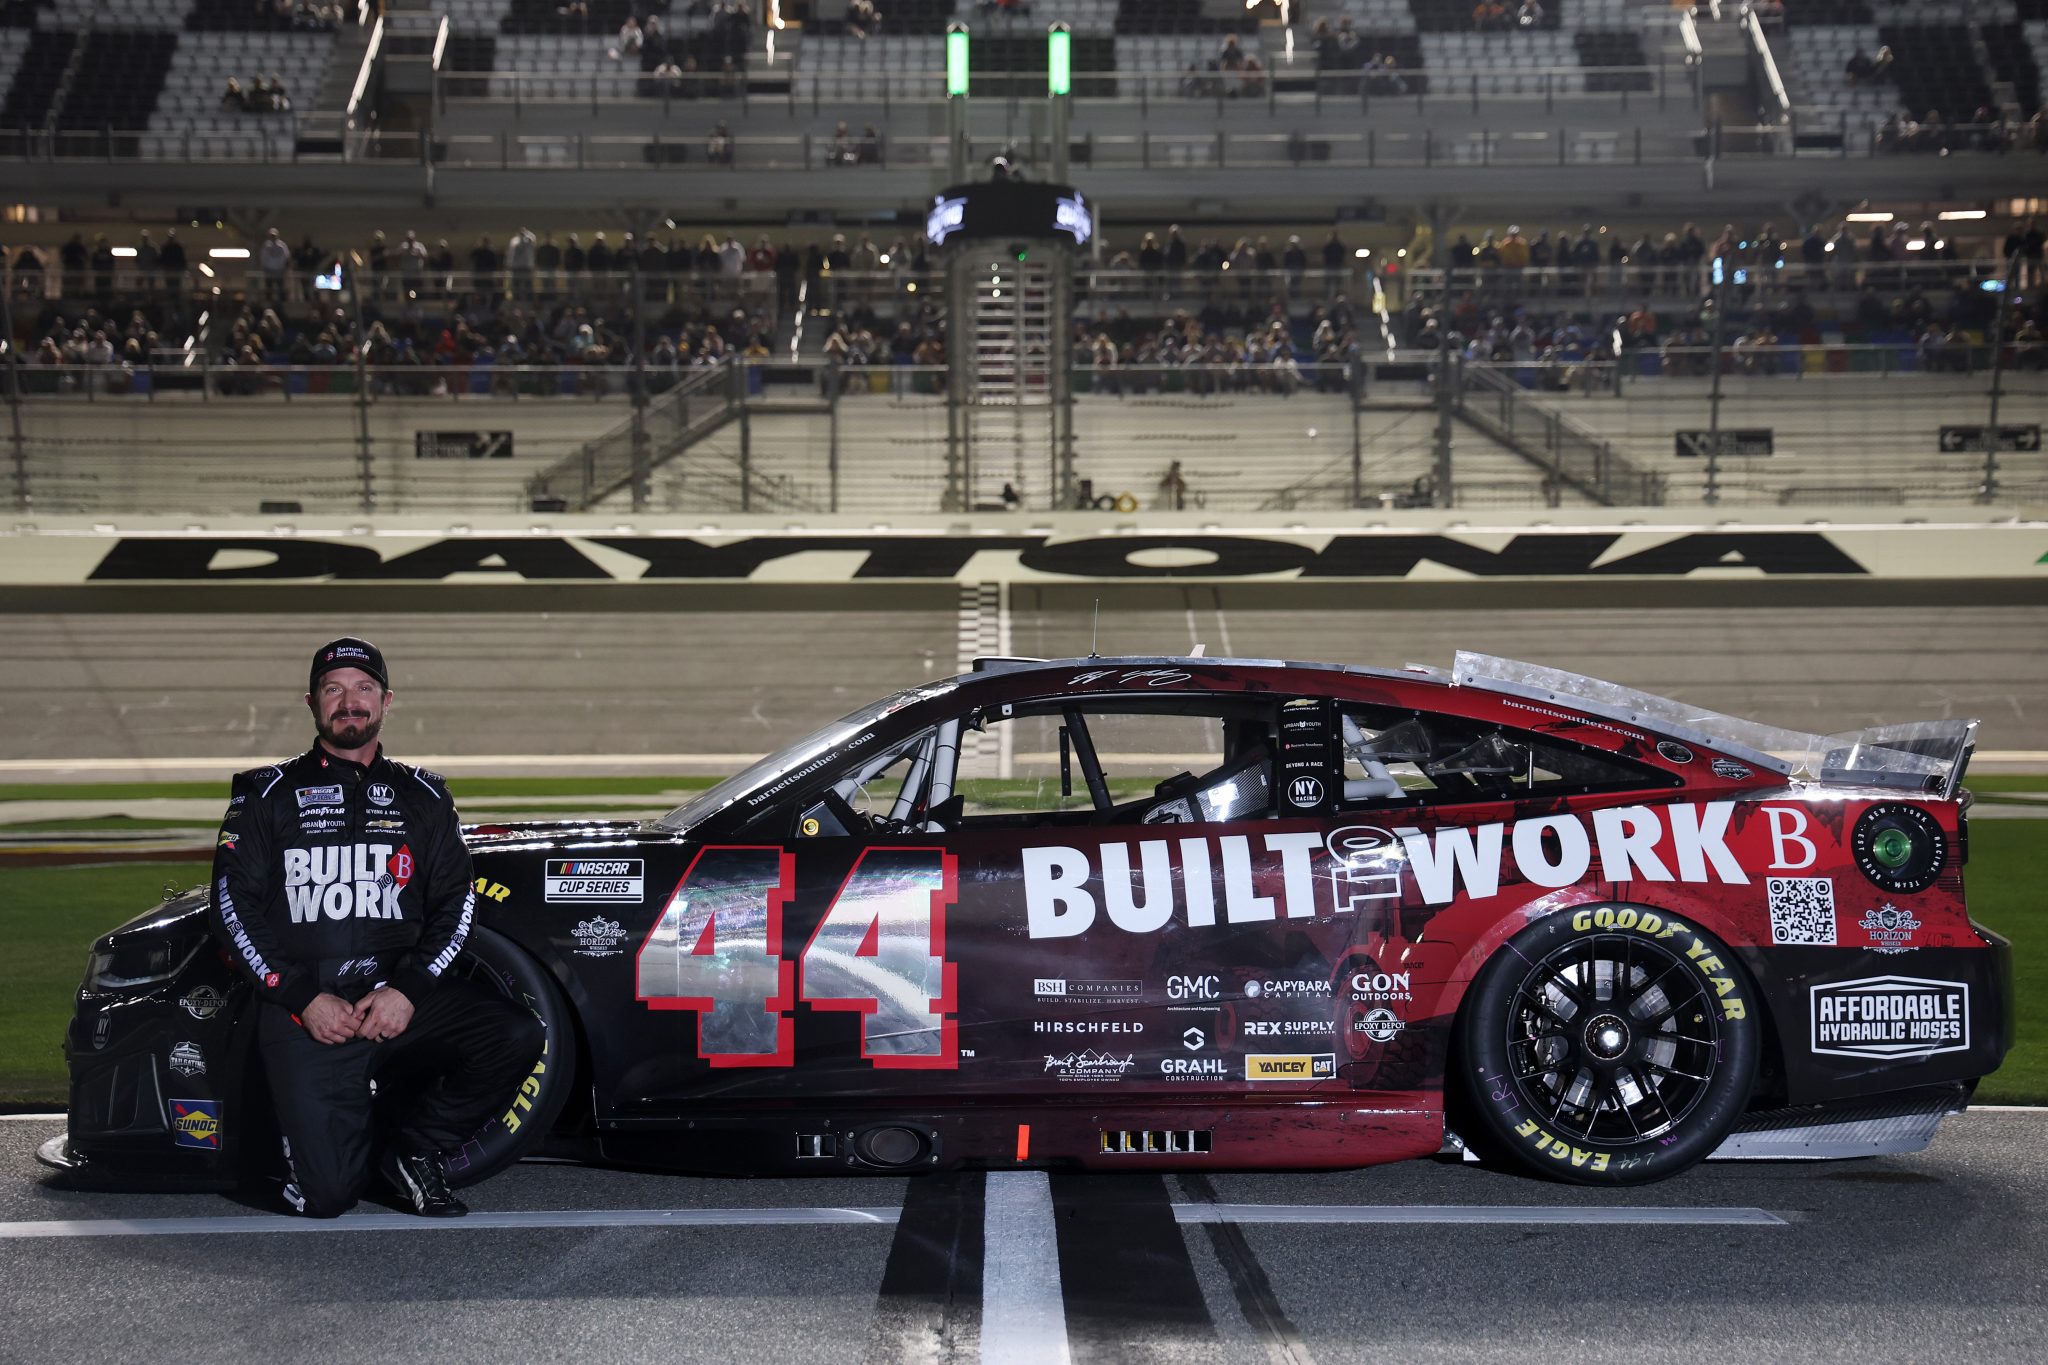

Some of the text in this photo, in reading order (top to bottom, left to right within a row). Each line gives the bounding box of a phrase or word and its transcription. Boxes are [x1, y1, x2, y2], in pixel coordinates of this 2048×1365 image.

[86, 533, 1871, 580] DAYTONA
[336, 652, 370, 660] Southern
[1502, 699, 1646, 741] barnettsouthern.com
[748, 731, 876, 806] barnettsouther.com
[373, 786, 388, 797] NY
[1295, 781, 1315, 795] NY
[299, 806, 345, 818] GOODYEAR
[1868, 807, 1886, 821] NEW
[1902, 807, 1928, 823] YORK
[326, 820, 345, 828] YOUTH
[1761, 807, 1817, 869] B
[284, 843, 392, 887] BUILT
[396, 853, 413, 879] B
[577, 863, 630, 875] NASCAR
[1022, 832, 1323, 939] BUILT
[1391, 801, 1751, 904] WORK
[558, 881, 630, 893] CUP SERIES
[285, 880, 406, 924] WORK
[218, 875, 238, 925] BUILT
[233, 929, 271, 981] WORK
[1869, 931, 1912, 940] HORIZON
[427, 939, 462, 977] BUILT
[635, 845, 959, 1070] 44
[1037, 981, 1139, 993] BSH COMPANIES
[1167, 975, 1220, 999] GMC
[1263, 980, 1332, 992] CAPYBARA
[1351, 971, 1411, 992] GON
[179, 999, 202, 1007] EPOXY
[1819, 994, 1961, 1022] AFFORDABLE
[1034, 1021, 1144, 1033] HIRSCHFELD
[1244, 1021, 1334, 1036] REX SUPPLY
[1354, 1021, 1406, 1030] EPOXY DEPOT
[1819, 1021, 1961, 1042] HYDRAULIC HOSES
[1160, 1058, 1228, 1073] GRAHL
[1258, 1061, 1332, 1073] YANCEY CAT
[1514, 1118, 1611, 1172] EAGLE
